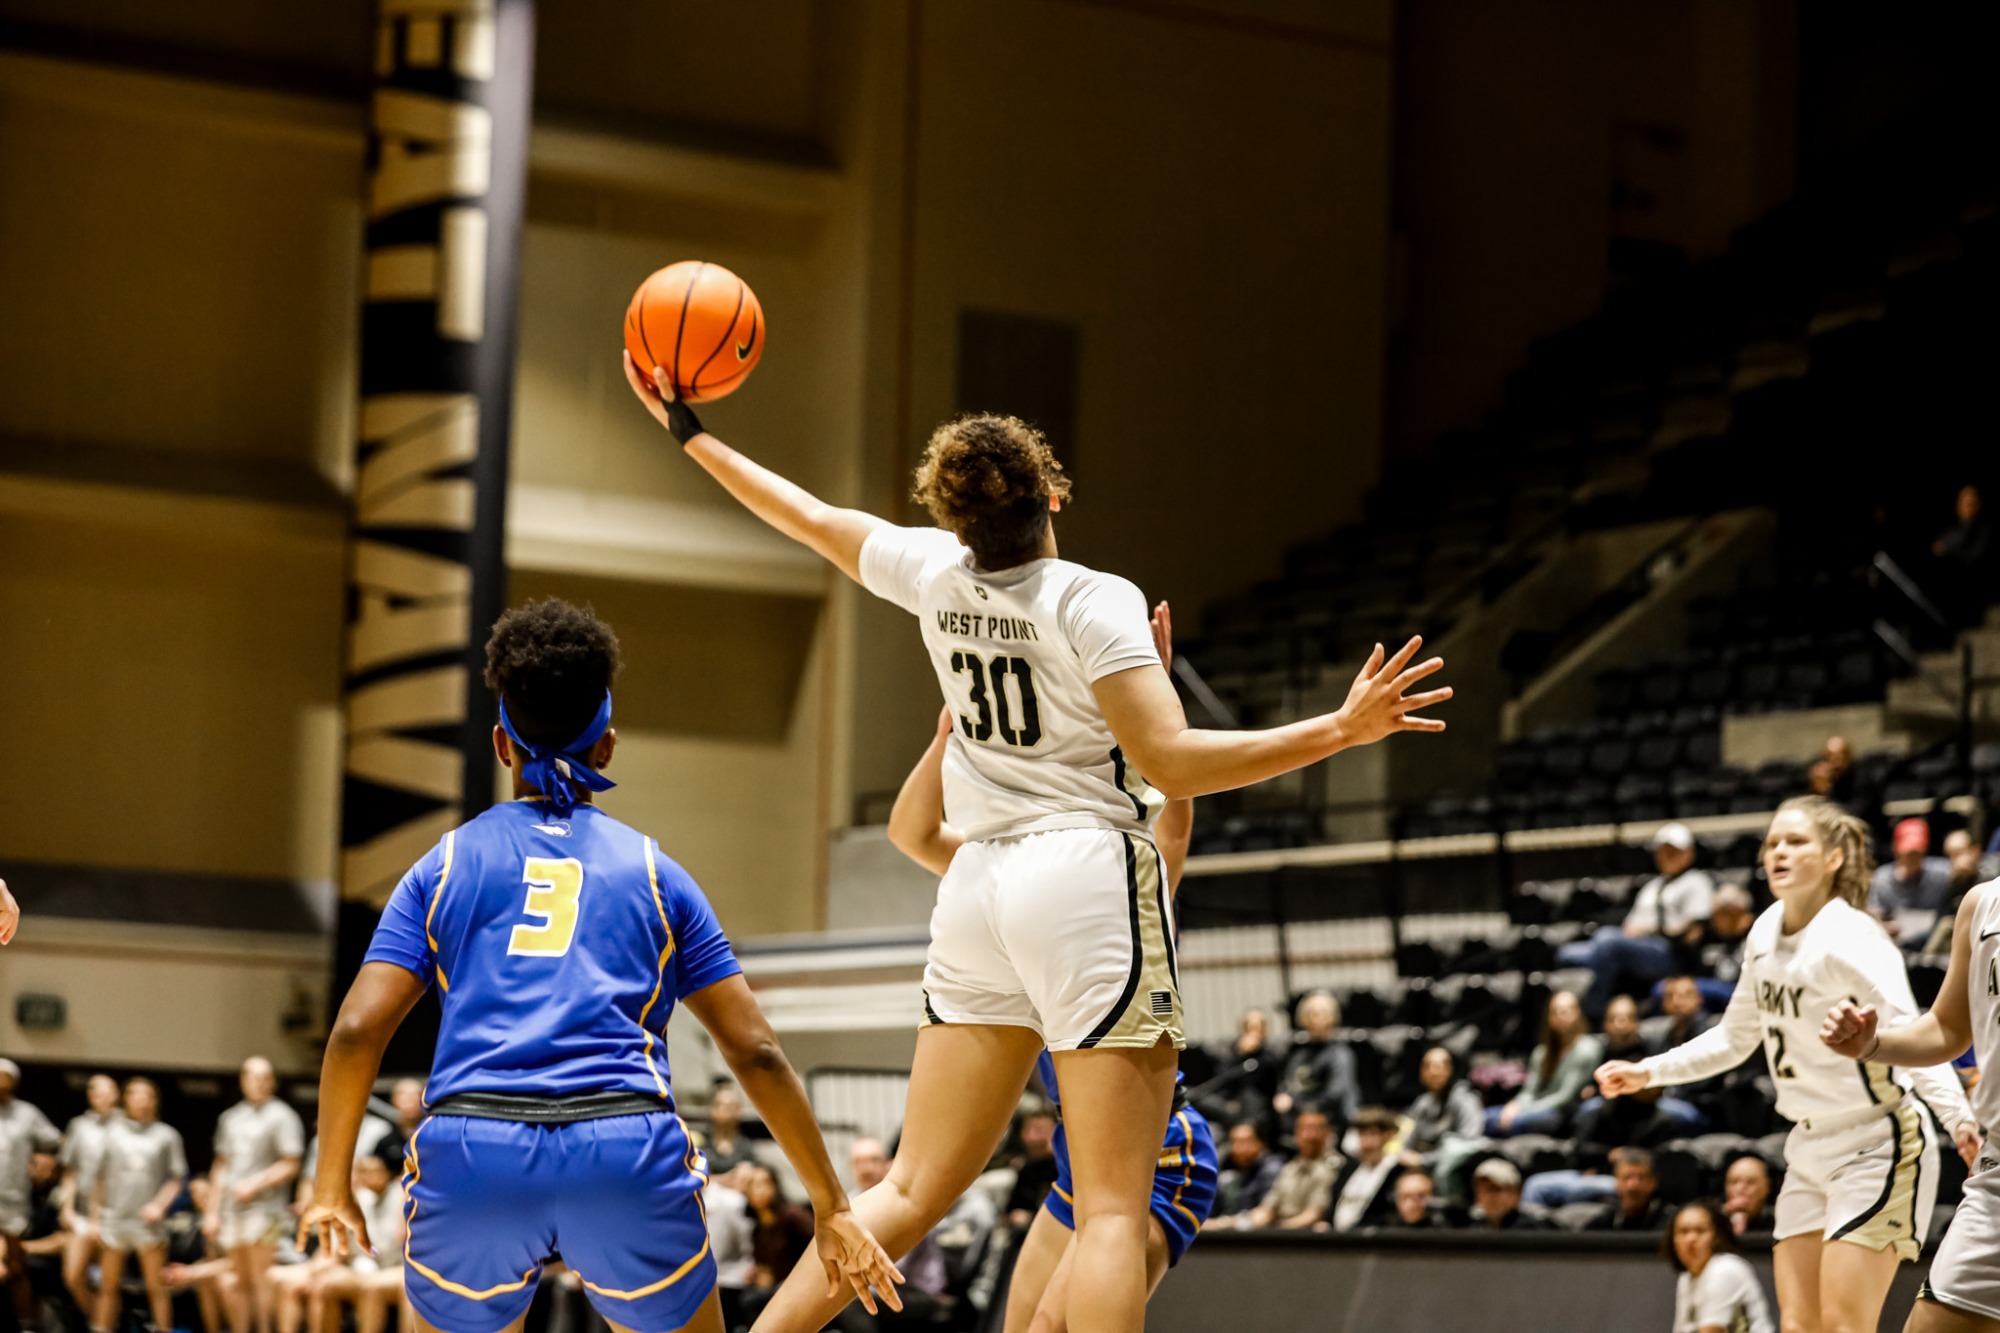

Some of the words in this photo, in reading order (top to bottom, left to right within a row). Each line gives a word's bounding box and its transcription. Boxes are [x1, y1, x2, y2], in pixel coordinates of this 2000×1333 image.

[937, 610, 984, 638] WEST
[987, 616, 1040, 641] POINT
[950, 648, 1043, 748] 30
[507, 856, 583, 957] 3
[1767, 1025, 1796, 1078] 2
